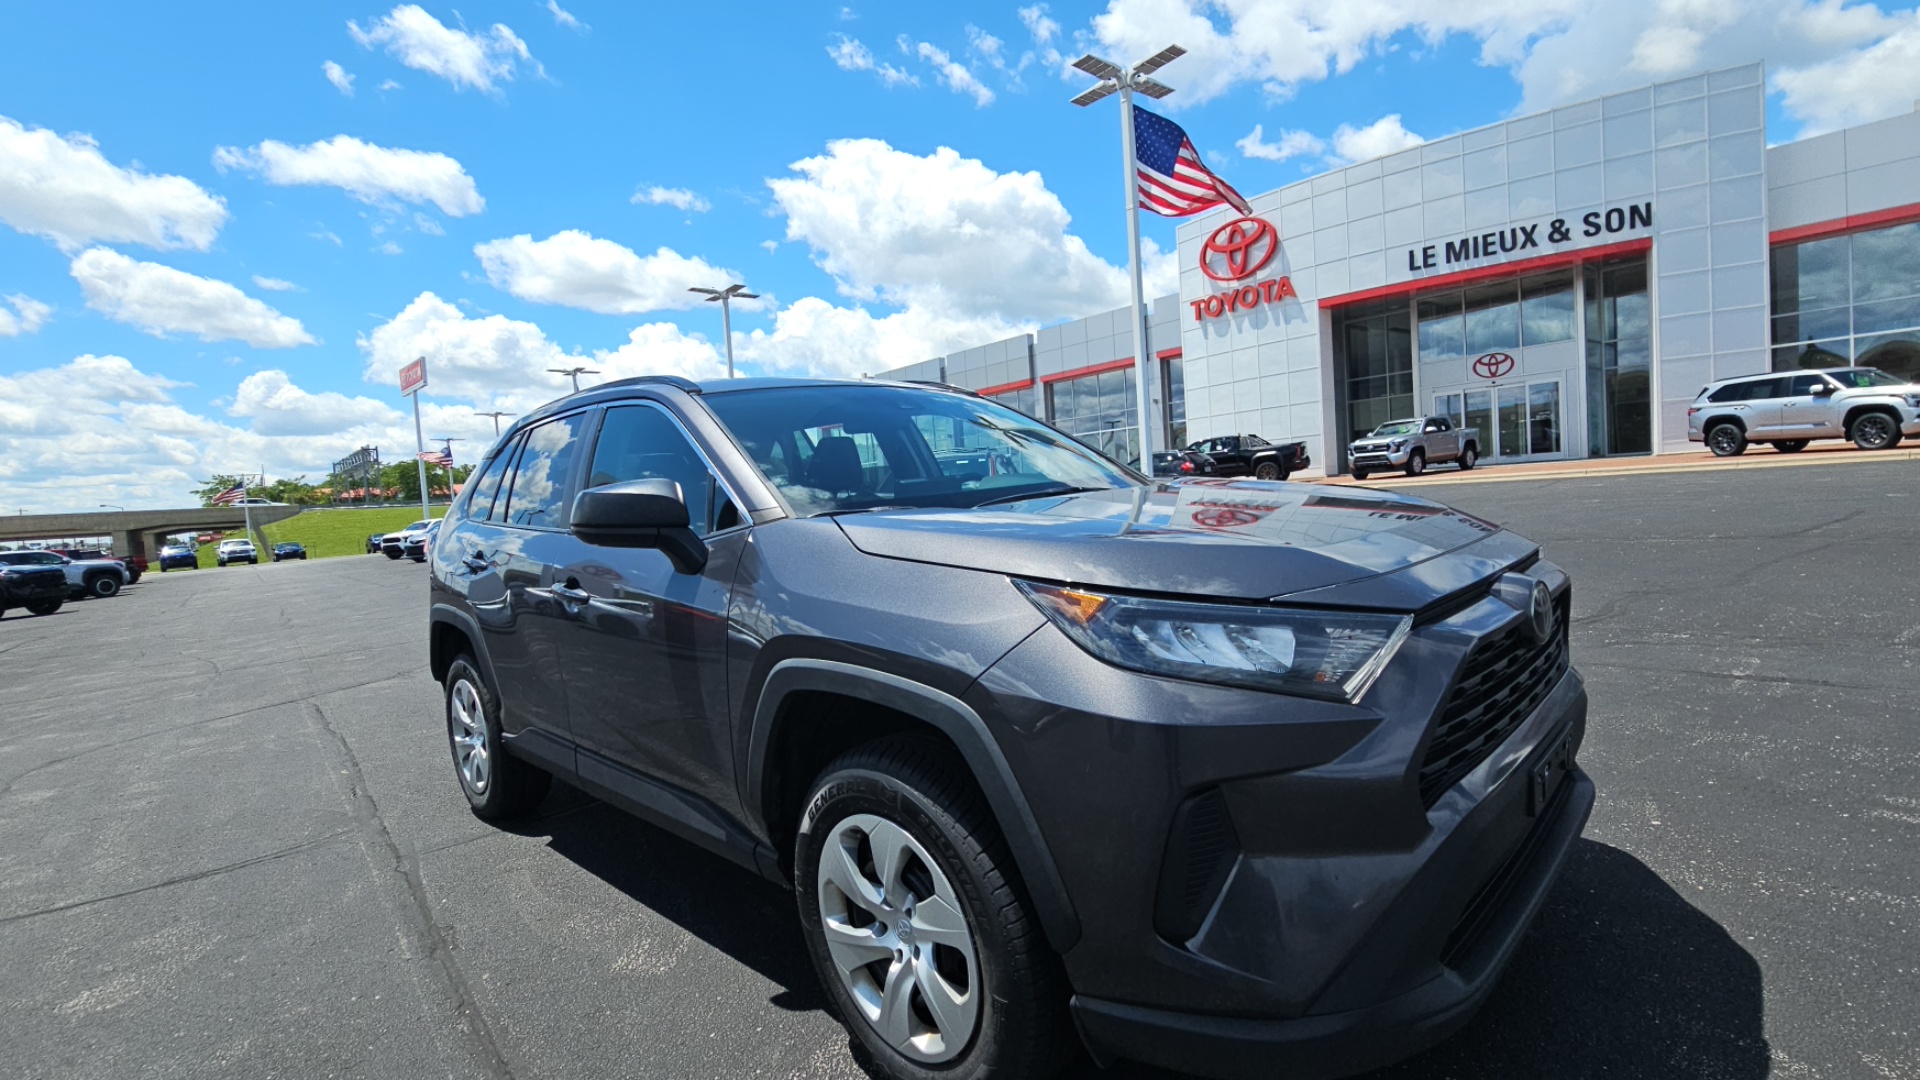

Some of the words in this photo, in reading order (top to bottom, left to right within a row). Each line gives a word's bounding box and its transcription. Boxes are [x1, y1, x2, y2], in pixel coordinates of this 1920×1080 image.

[1408, 245, 1437, 271] LE
[1445, 223, 1538, 264] MIEUX
[1548, 218, 1572, 243] &
[1583, 202, 1652, 237] SON
[1190, 276, 1297, 321] TOYOTA
[808, 780, 867, 823] GENERAL
